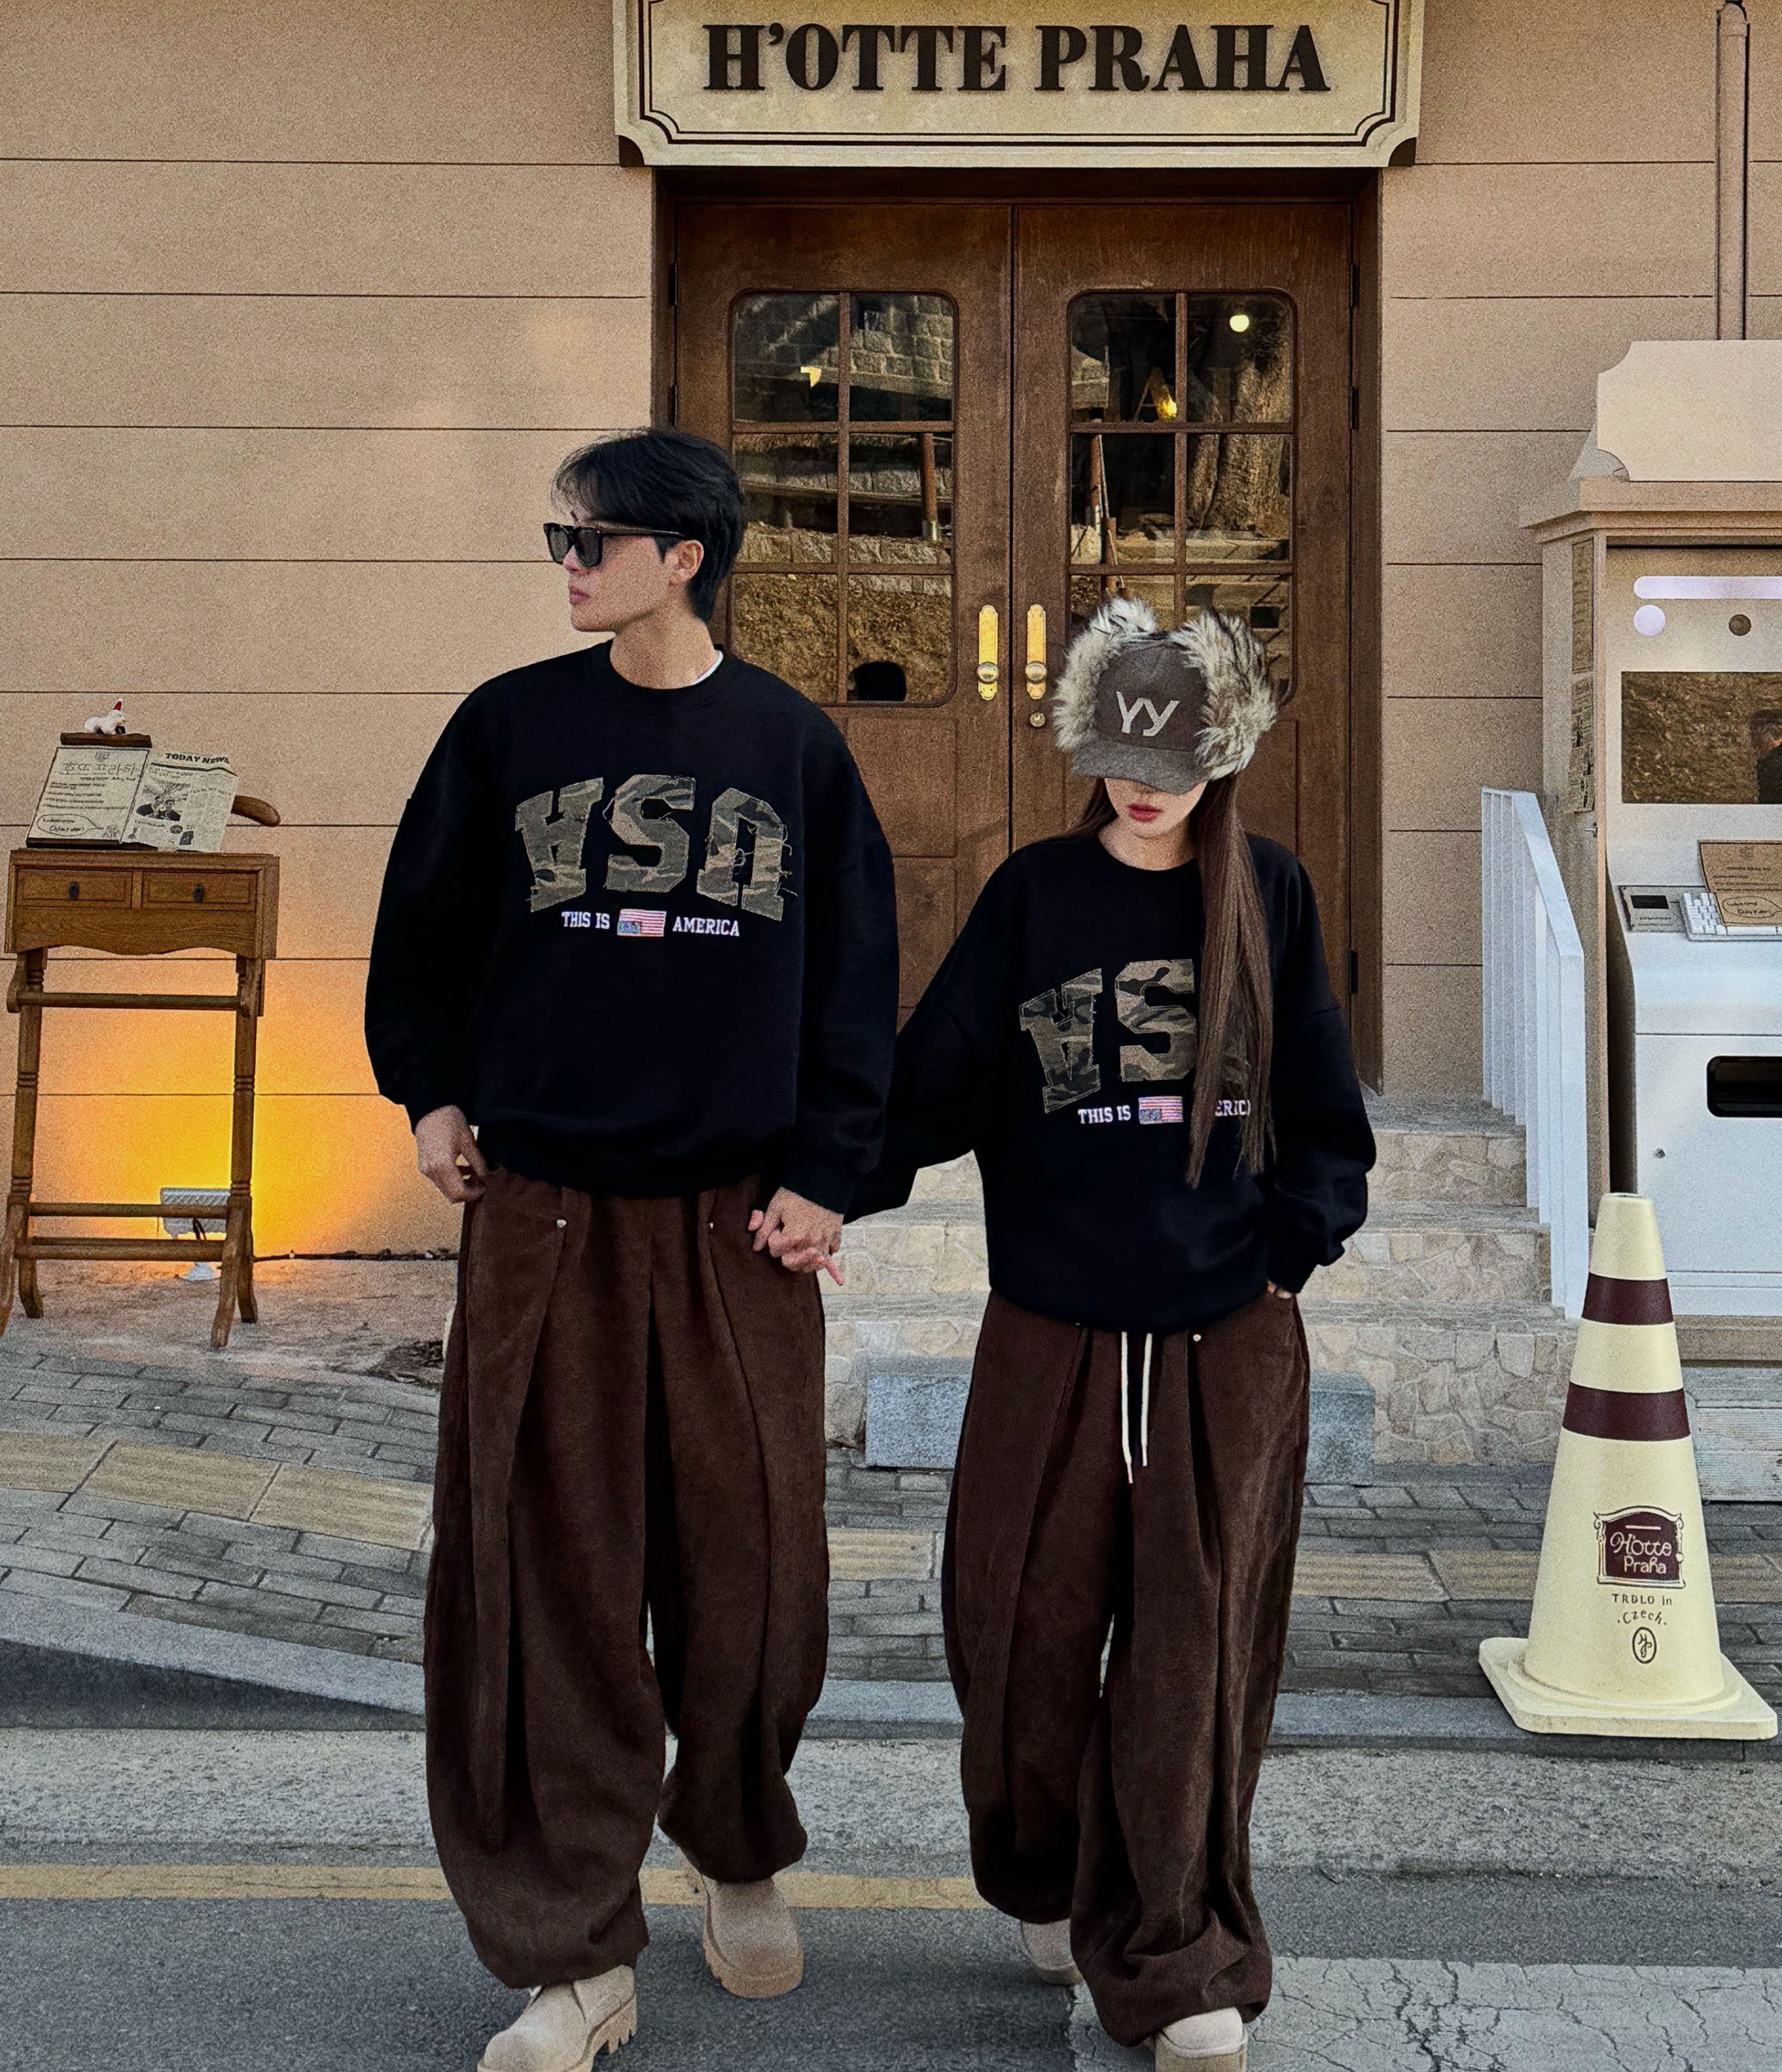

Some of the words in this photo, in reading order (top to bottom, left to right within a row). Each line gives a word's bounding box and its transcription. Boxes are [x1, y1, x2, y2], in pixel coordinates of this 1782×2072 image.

[1035, 23, 1331, 92] PRAHA
[165, 753, 201, 762] TODAY
[561, 911, 591, 928] THIS
[595, 913, 610, 930] IS
[673, 917, 740, 937] AMERICA
[1078, 1107, 1113, 1124] THIS
[1117, 1105, 1132, 1122] IS
[1624, 1555, 1667, 1574] Praha
[1611, 1594, 1654, 1605] TRDLO
